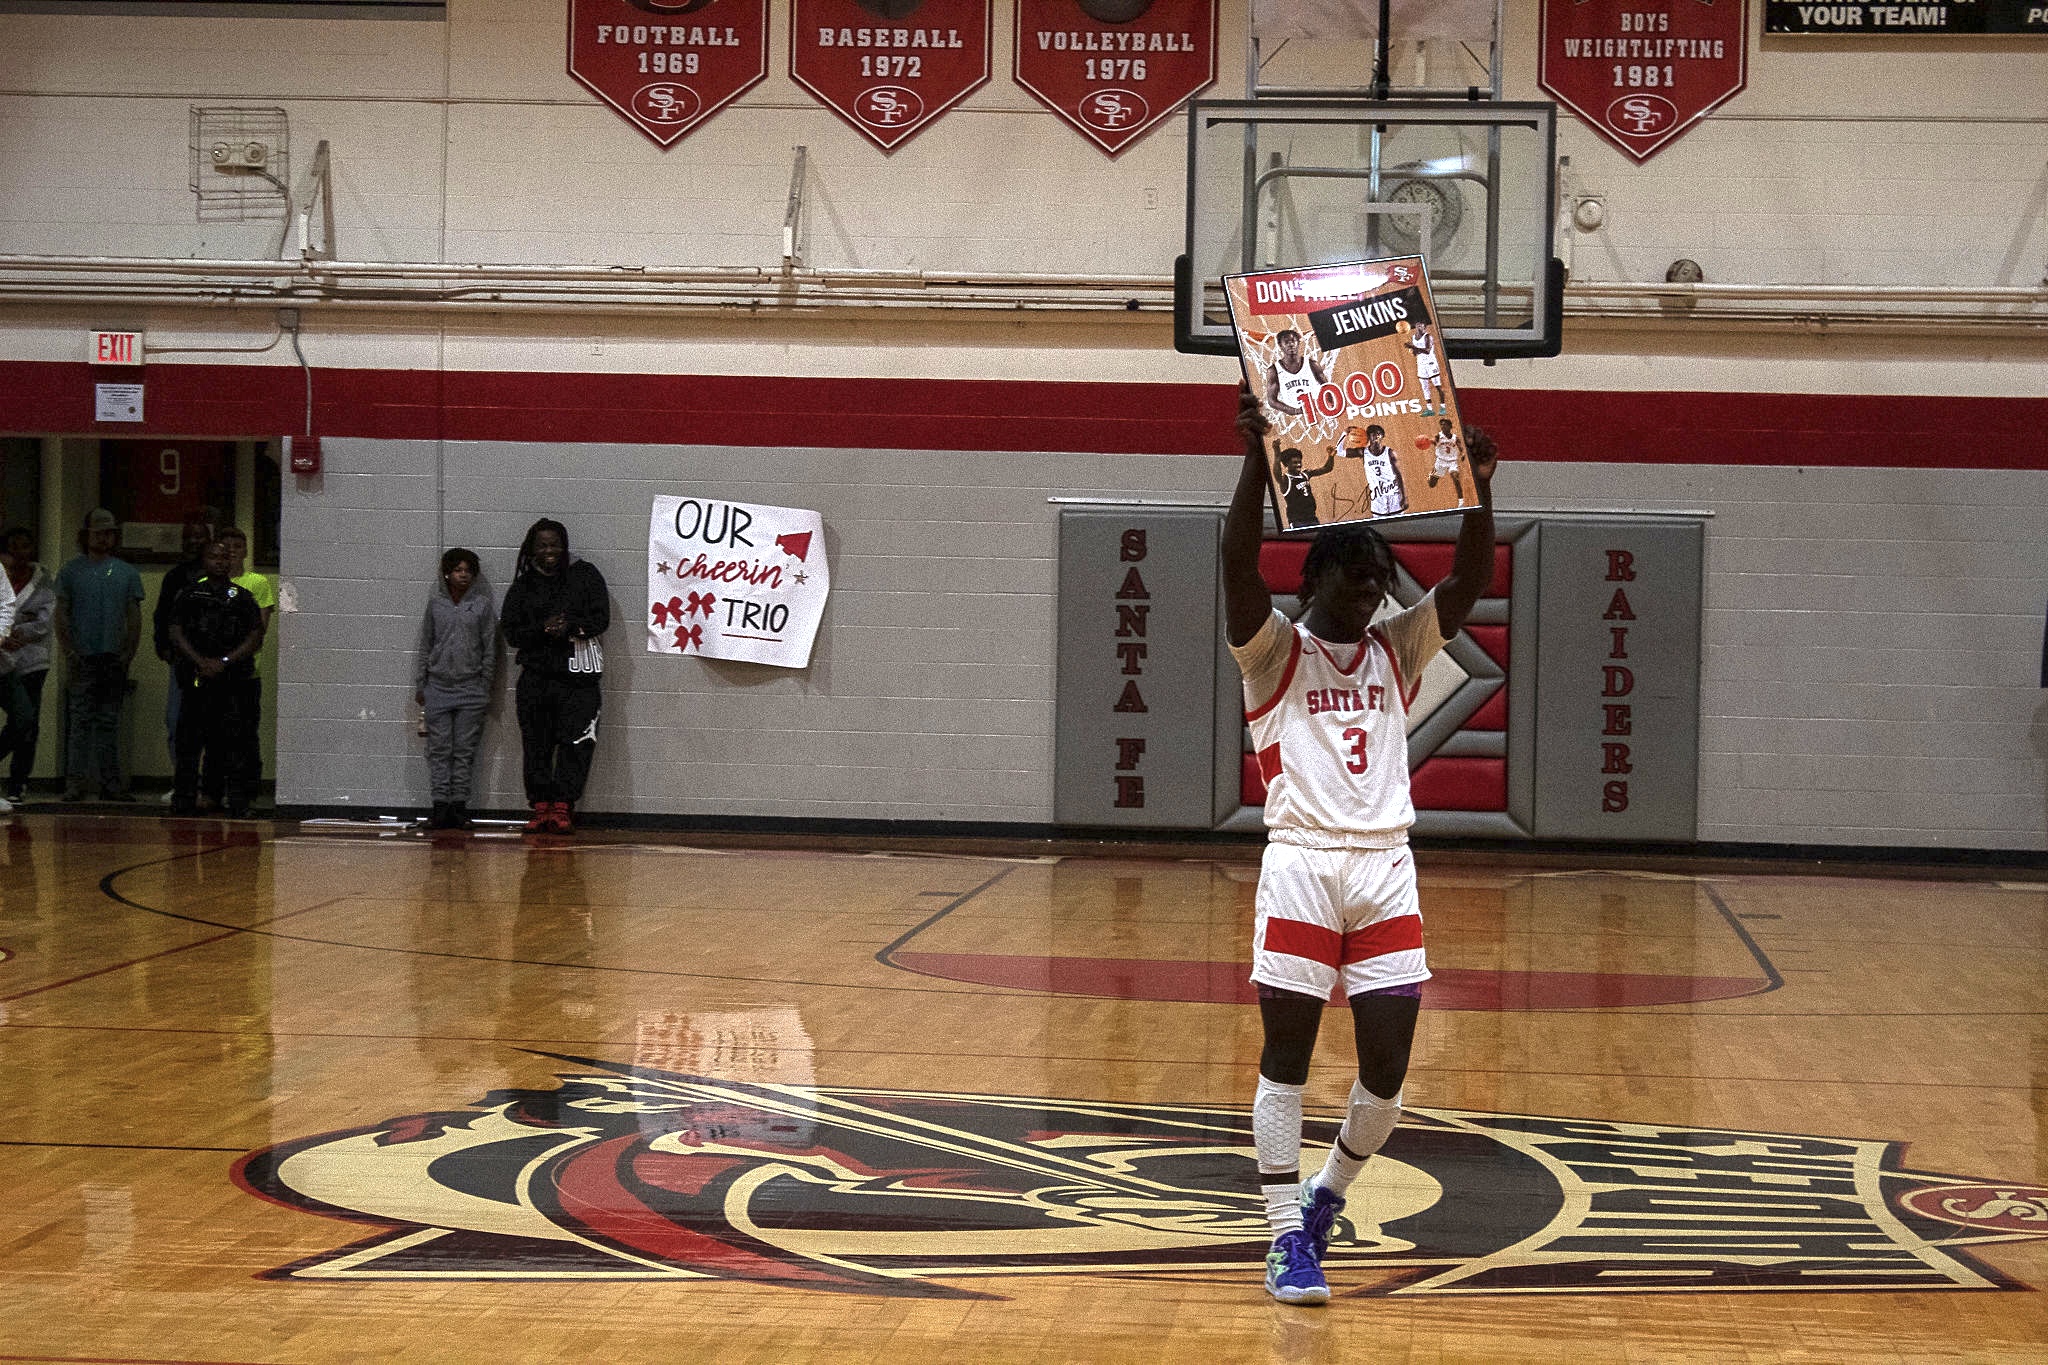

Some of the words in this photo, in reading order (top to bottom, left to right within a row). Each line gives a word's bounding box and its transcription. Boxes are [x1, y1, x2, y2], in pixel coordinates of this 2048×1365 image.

[1621, 13, 1669, 32] BOYS
[1799, 6, 1863, 25] YOUR
[1870, 6, 1946, 25] TEAM!
[597, 25, 740, 46] FOOTBALL
[819, 28, 963, 49] BASEBALL
[1036, 31, 1195, 53] VOLLEYBALL
[1564, 38, 1724, 59] WEIGHTLIFTING
[638, 52, 699, 74] 1969
[861, 56, 921, 78] 1972
[1085, 59, 1147, 80] 1976
[1613, 65, 1675, 88] 1981
[648, 87, 685, 119] SF
[871, 92, 907, 125] SF
[1094, 94, 1132, 127] SF
[1623, 99, 1662, 131] SF
[1332, 297, 1408, 336] JENKINS
[97, 333, 135, 362] EXIT
[1297, 361, 1404, 426] 1000
[1346, 398, 1422, 420] POINTS
[159, 448, 180, 495] 9
[1375, 466, 1382, 476] 3
[675, 500, 754, 548] OUR
[721, 597, 789, 633] TRIO
[1113, 529, 1150, 713] SANTA
[1601, 550, 1637, 813] RAIDERS
[1342, 727, 1368, 774] 3
[1113, 738, 1146, 808] FE
